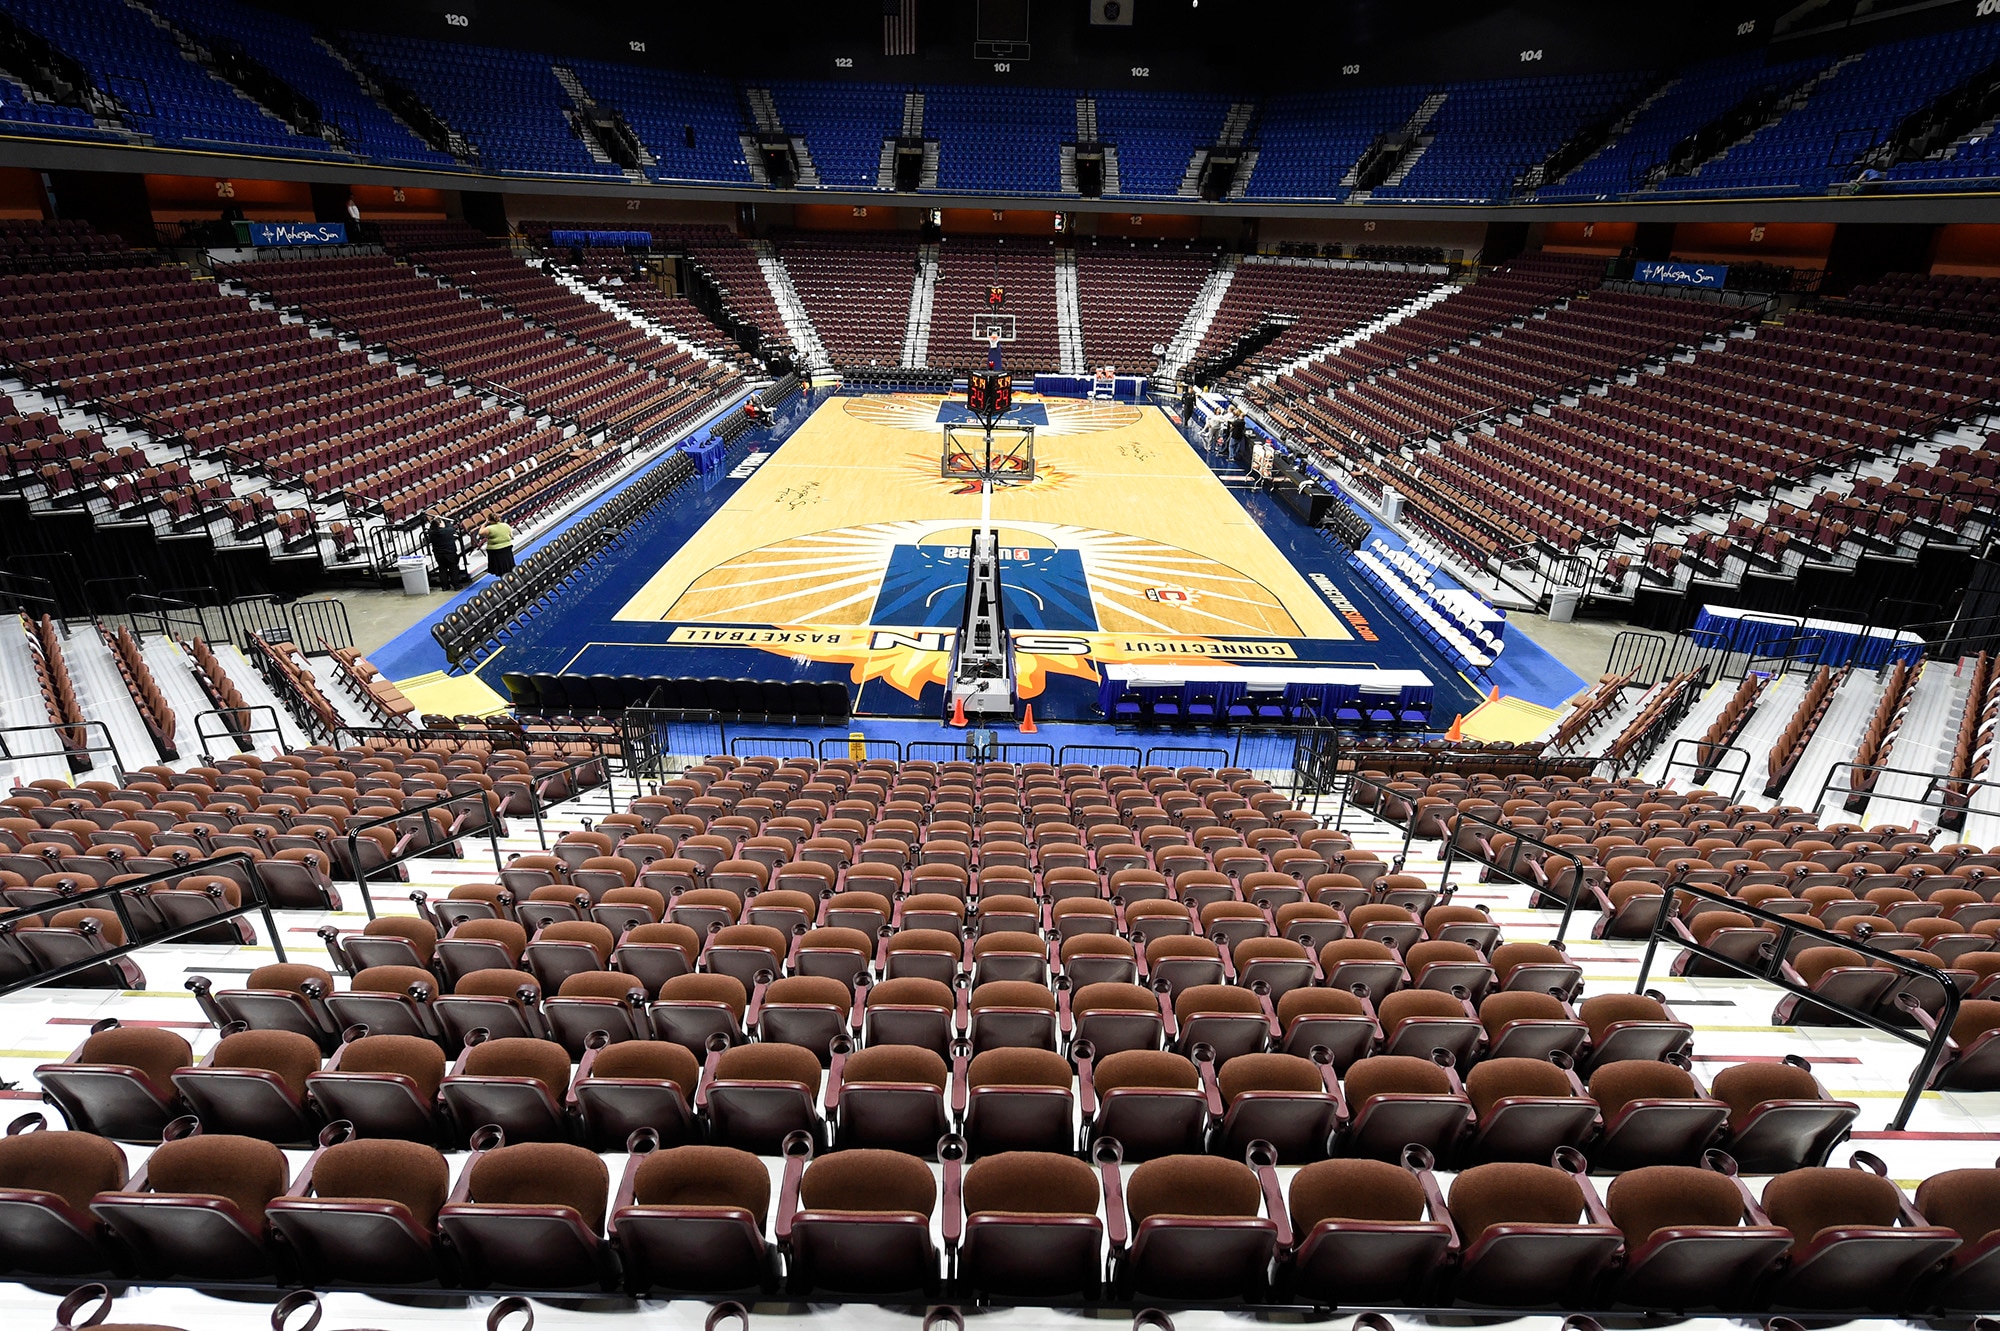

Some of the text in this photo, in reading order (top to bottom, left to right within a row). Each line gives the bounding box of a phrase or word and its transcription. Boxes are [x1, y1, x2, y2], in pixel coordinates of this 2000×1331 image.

[444, 13, 469, 27] 120
[1736, 19, 1756, 36] 105
[628, 40, 646, 52] 121
[1520, 49, 1543, 62] 104
[834, 57, 853, 68] 122
[993, 62, 1010, 73] 101
[1131, 67, 1150, 77] 102
[1342, 64, 1360, 75] 103
[215, 181, 235, 198] 25
[393, 190, 406, 203] 26
[626, 200, 641, 211] 27
[852, 207, 867, 218] 28
[992, 212, 1003, 221] 11
[1129, 216, 1142, 225] 12
[1363, 221, 1376, 232] 13
[276, 226, 339, 243] Mohegan Sun
[1582, 224, 1594, 238] 14
[1749, 226, 1766, 242] 15
[1652, 265, 1714, 283] Mohegan Sun
[970, 387, 984, 409] 24
[995, 389, 1009, 410] 24
[686, 630, 841, 644] BASKETBALL
[869, 631, 1092, 656] SN
[1124, 642, 1286, 656] CONNECTICUT
